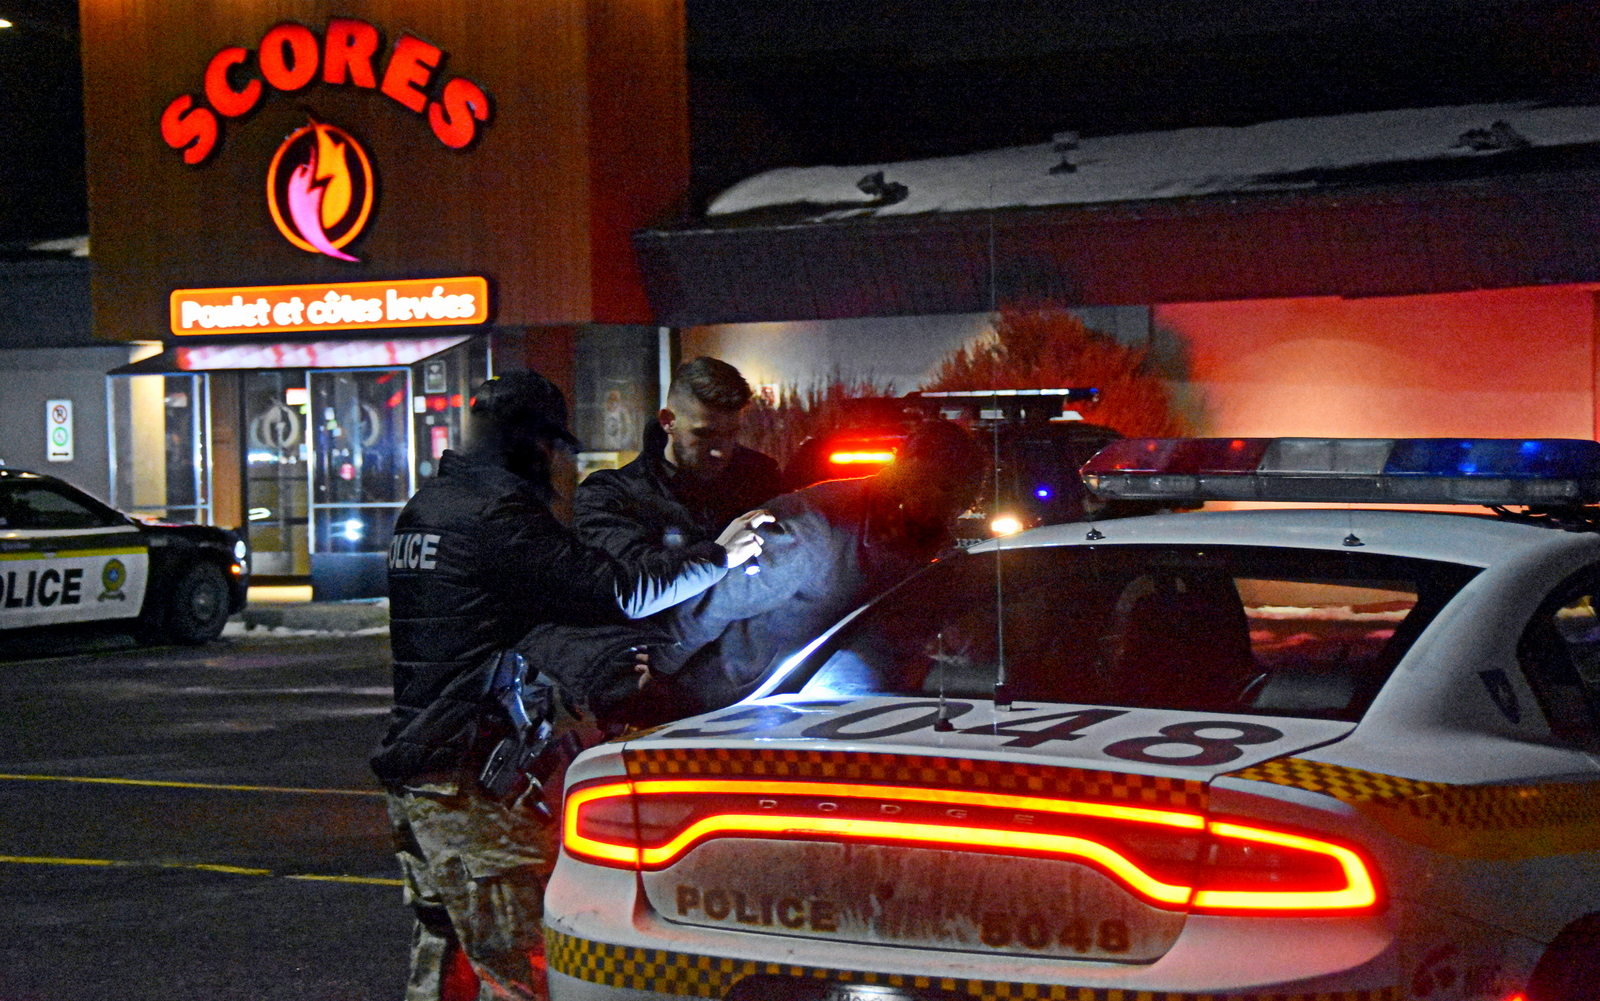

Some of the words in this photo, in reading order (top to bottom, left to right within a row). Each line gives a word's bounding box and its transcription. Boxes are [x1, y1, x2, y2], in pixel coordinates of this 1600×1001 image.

[161, 19, 489, 164] SCORES
[181, 296, 271, 328] Poulet
[273, 297, 304, 326] et
[306, 291, 383, 323] côtes
[386, 286, 476, 320] levées
[0, 568, 84, 608] LICE
[662, 700, 1284, 767] 5048
[759, 799, 1035, 825] DODGE
[676, 885, 839, 933] POLICE
